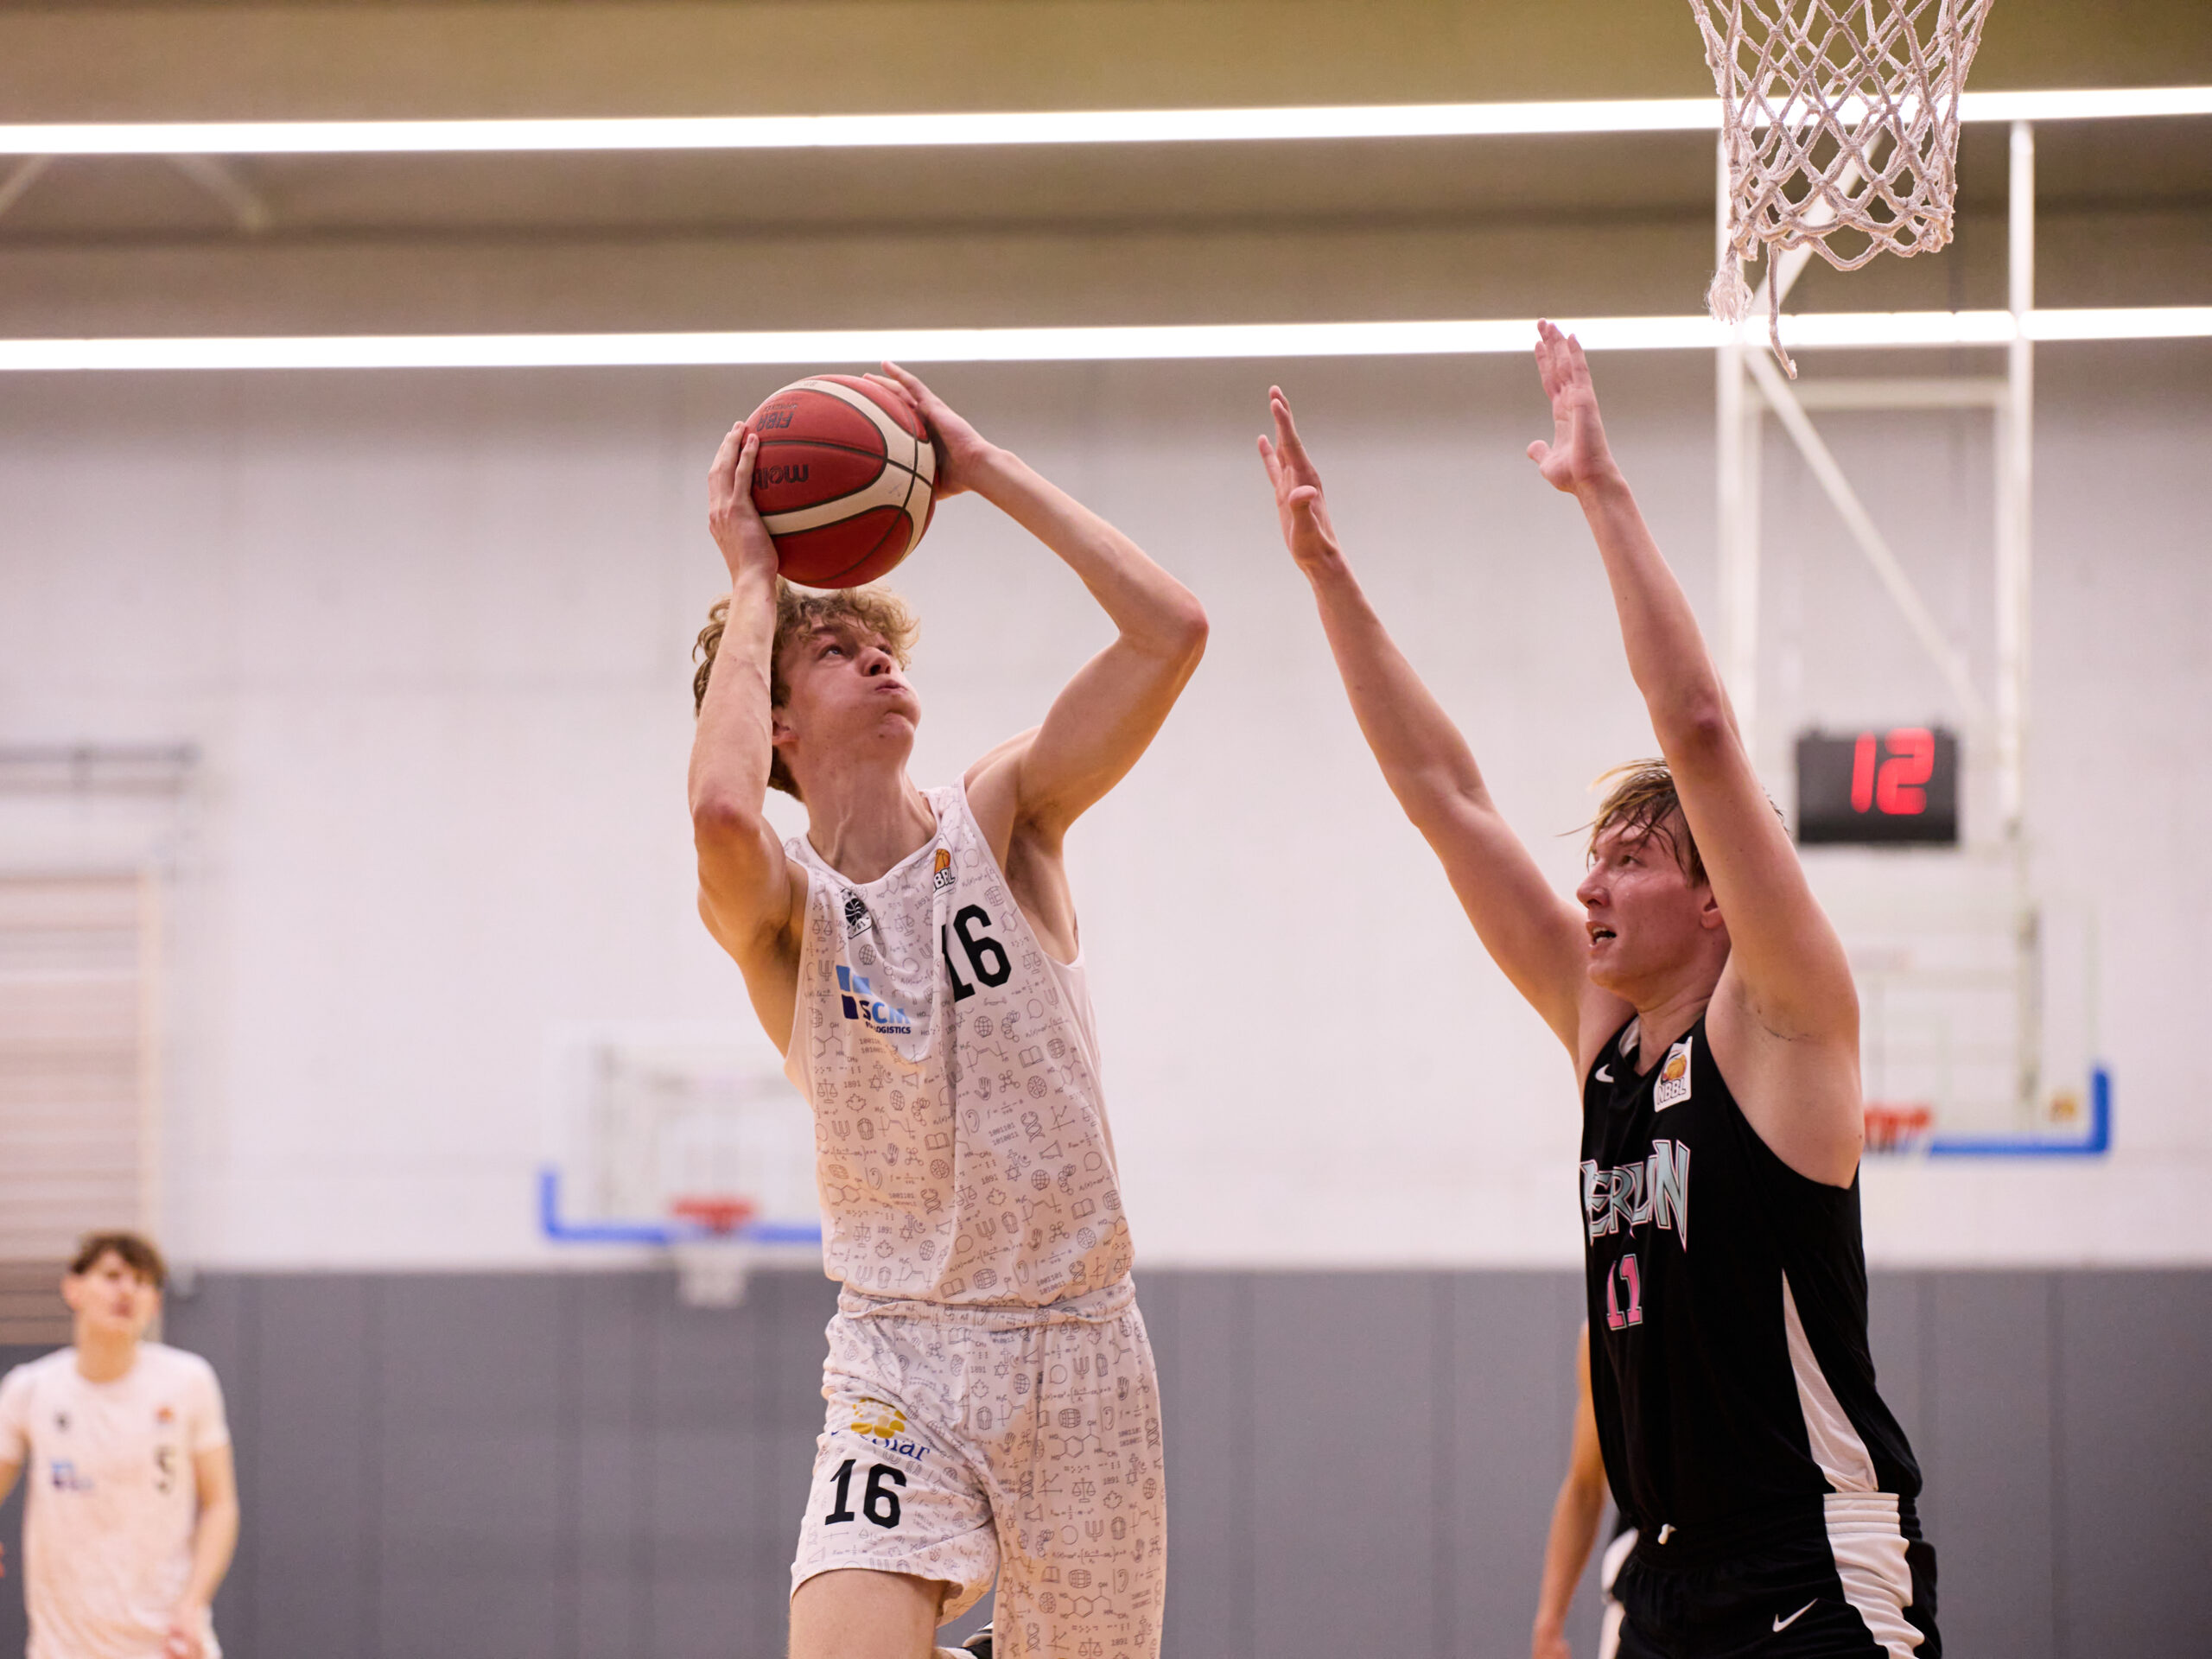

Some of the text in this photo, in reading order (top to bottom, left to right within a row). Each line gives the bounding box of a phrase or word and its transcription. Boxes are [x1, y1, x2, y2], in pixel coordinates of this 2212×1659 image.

[757, 412, 794, 432] FIBA
[752, 464, 809, 489] molt
[1850, 728, 1935, 815] 12
[933, 867, 956, 893] BBL
[941, 904, 1012, 1002] 16
[859, 1000, 911, 1025] SCM
[1657, 1077, 1687, 1105] NBBL
[1607, 1254, 1643, 1331] 11
[825, 1459, 907, 1529] 16
